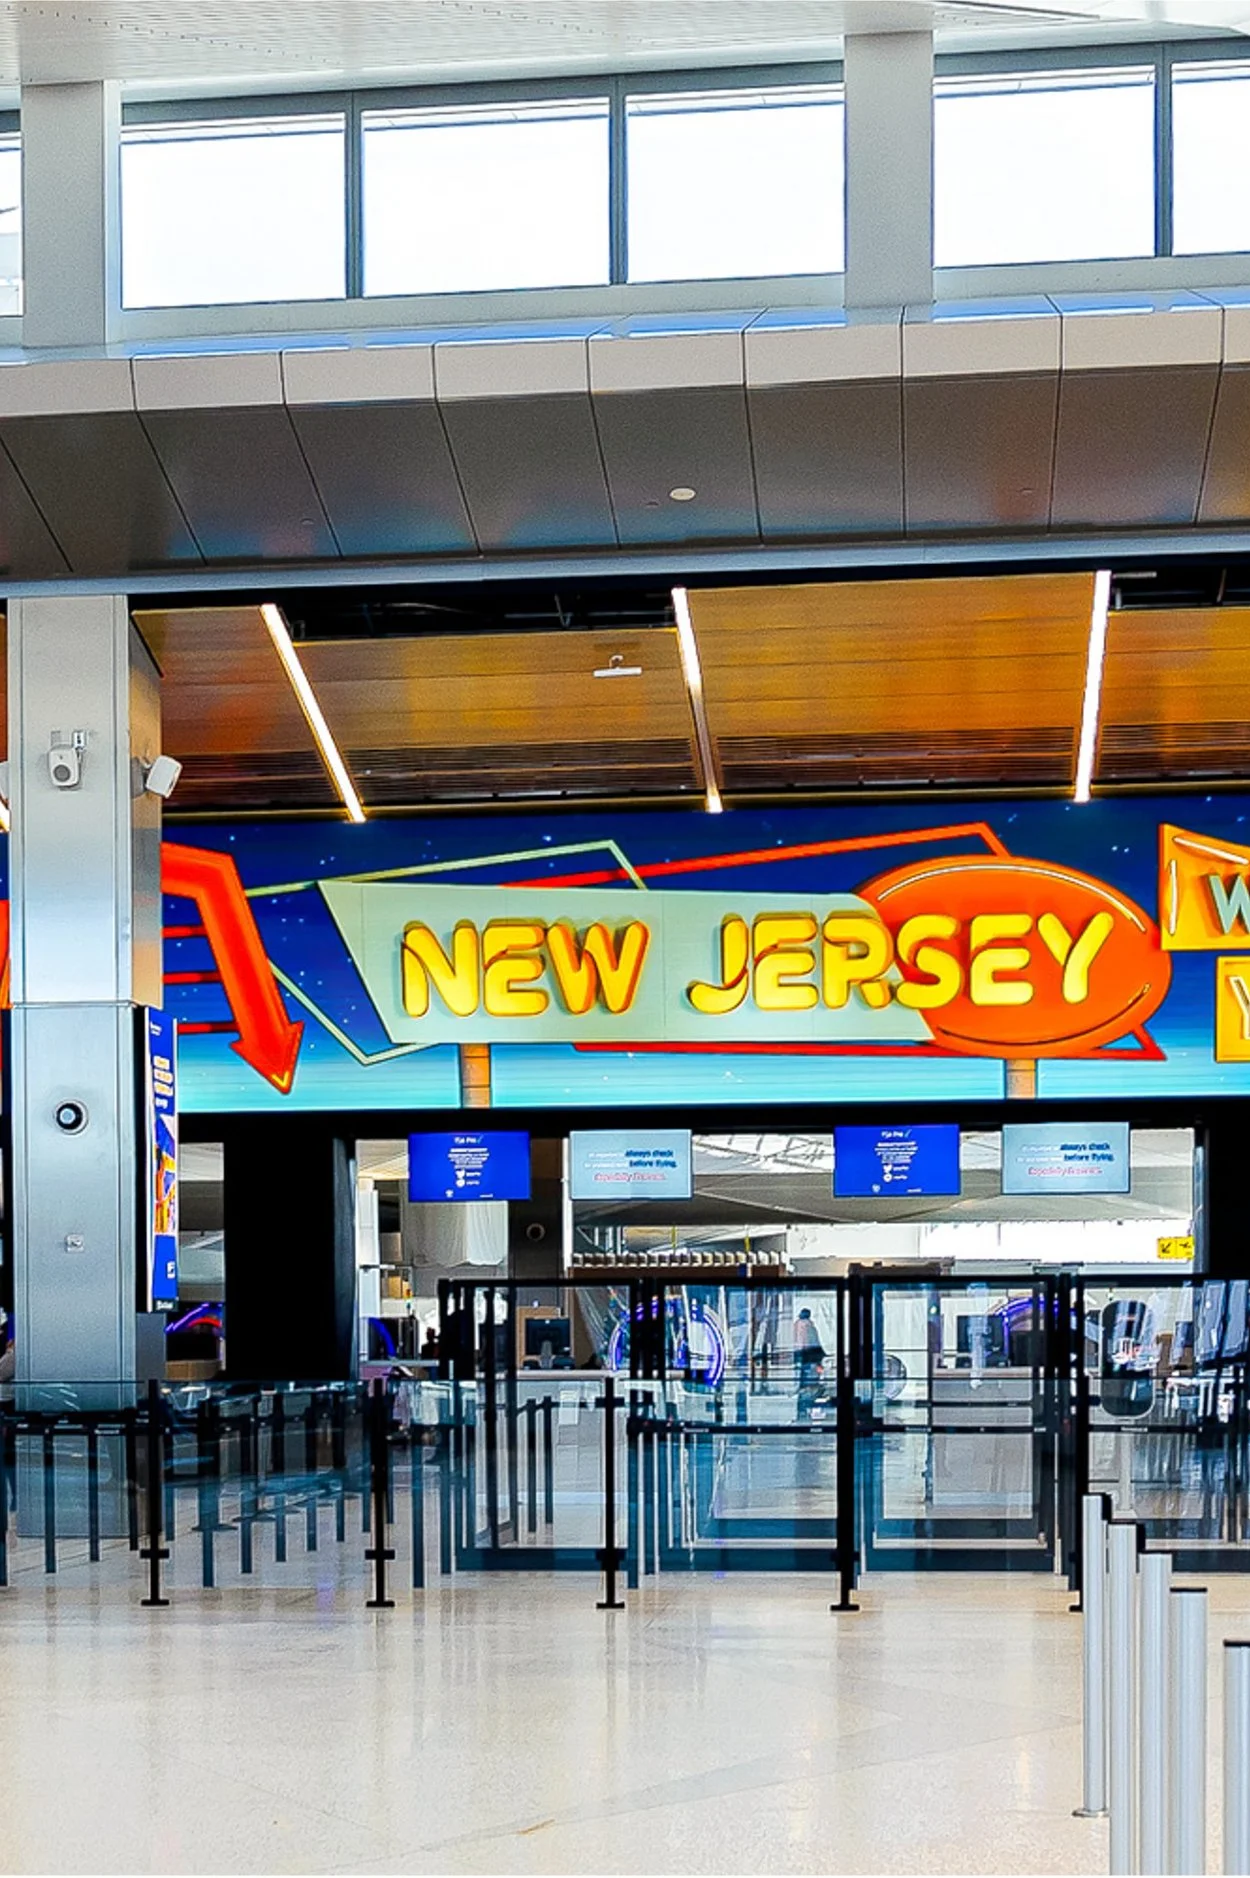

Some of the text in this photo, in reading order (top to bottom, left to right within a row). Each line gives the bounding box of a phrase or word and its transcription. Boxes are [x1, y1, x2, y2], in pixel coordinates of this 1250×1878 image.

[402, 911, 1114, 1017] NEW JERSEY
[1063, 1153, 1090, 1161] before
[629, 1159, 654, 1167] before
